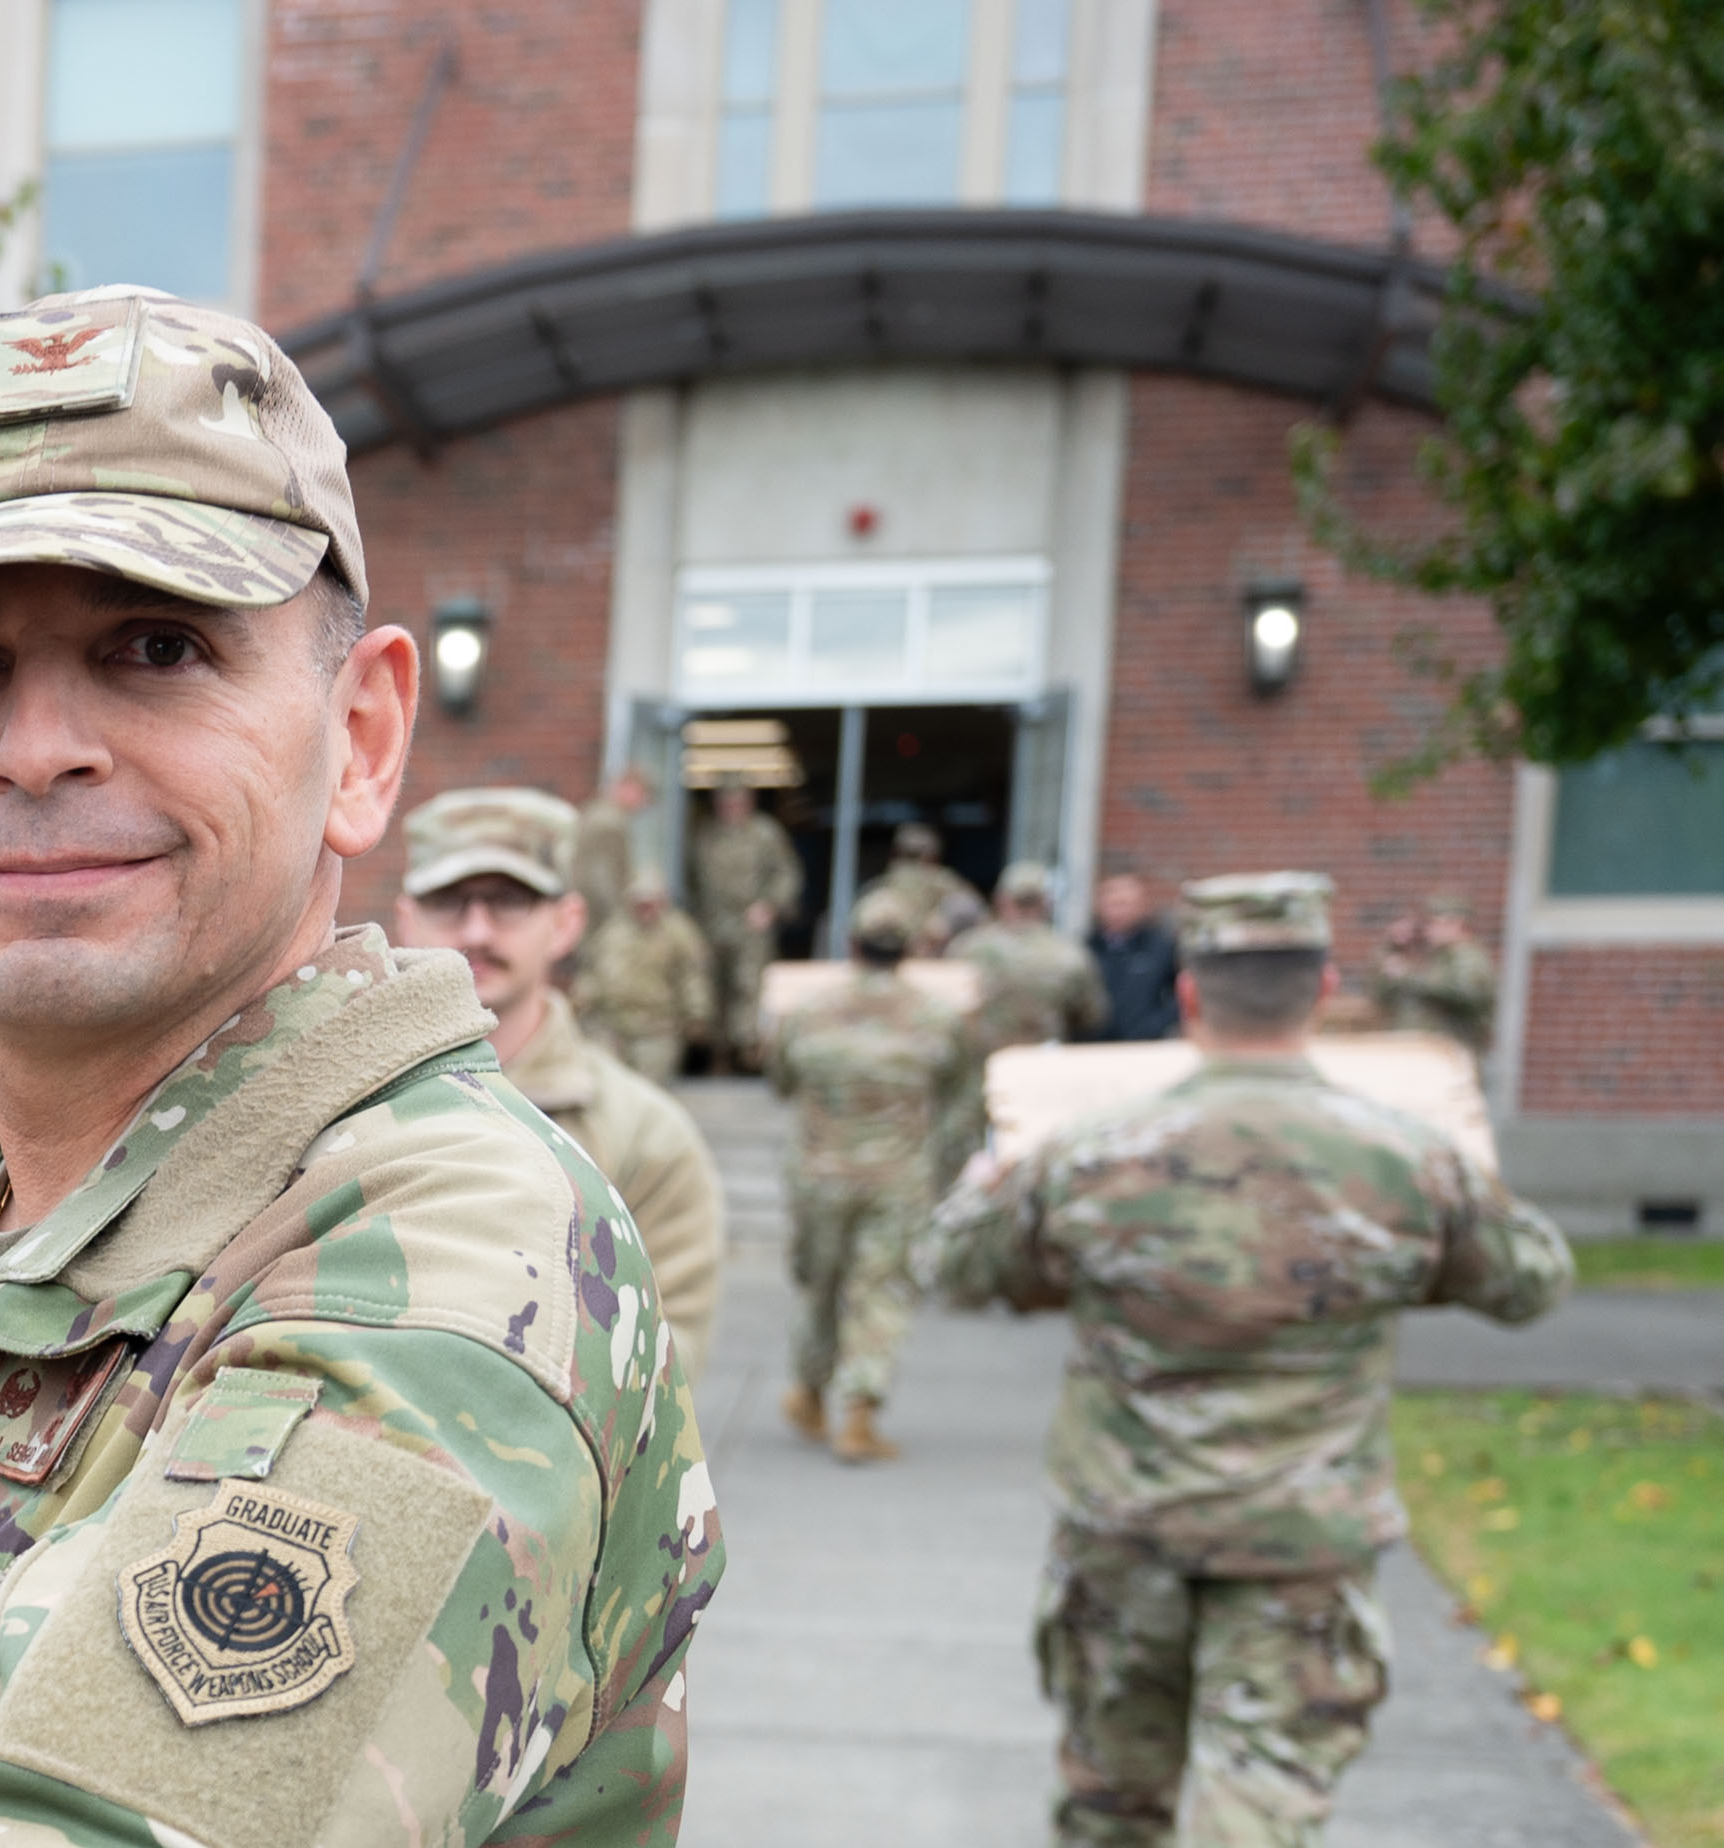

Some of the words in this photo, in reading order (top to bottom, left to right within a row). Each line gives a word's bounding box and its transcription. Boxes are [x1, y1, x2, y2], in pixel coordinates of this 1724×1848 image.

[225, 1495, 339, 1550] GRADUATE
[143, 1600, 170, 1626] AIR
[152, 1626, 200, 1676] FORCE
[270, 1631, 323, 1684] SCHOOL
[188, 1667, 274, 1698] WEAPONS
